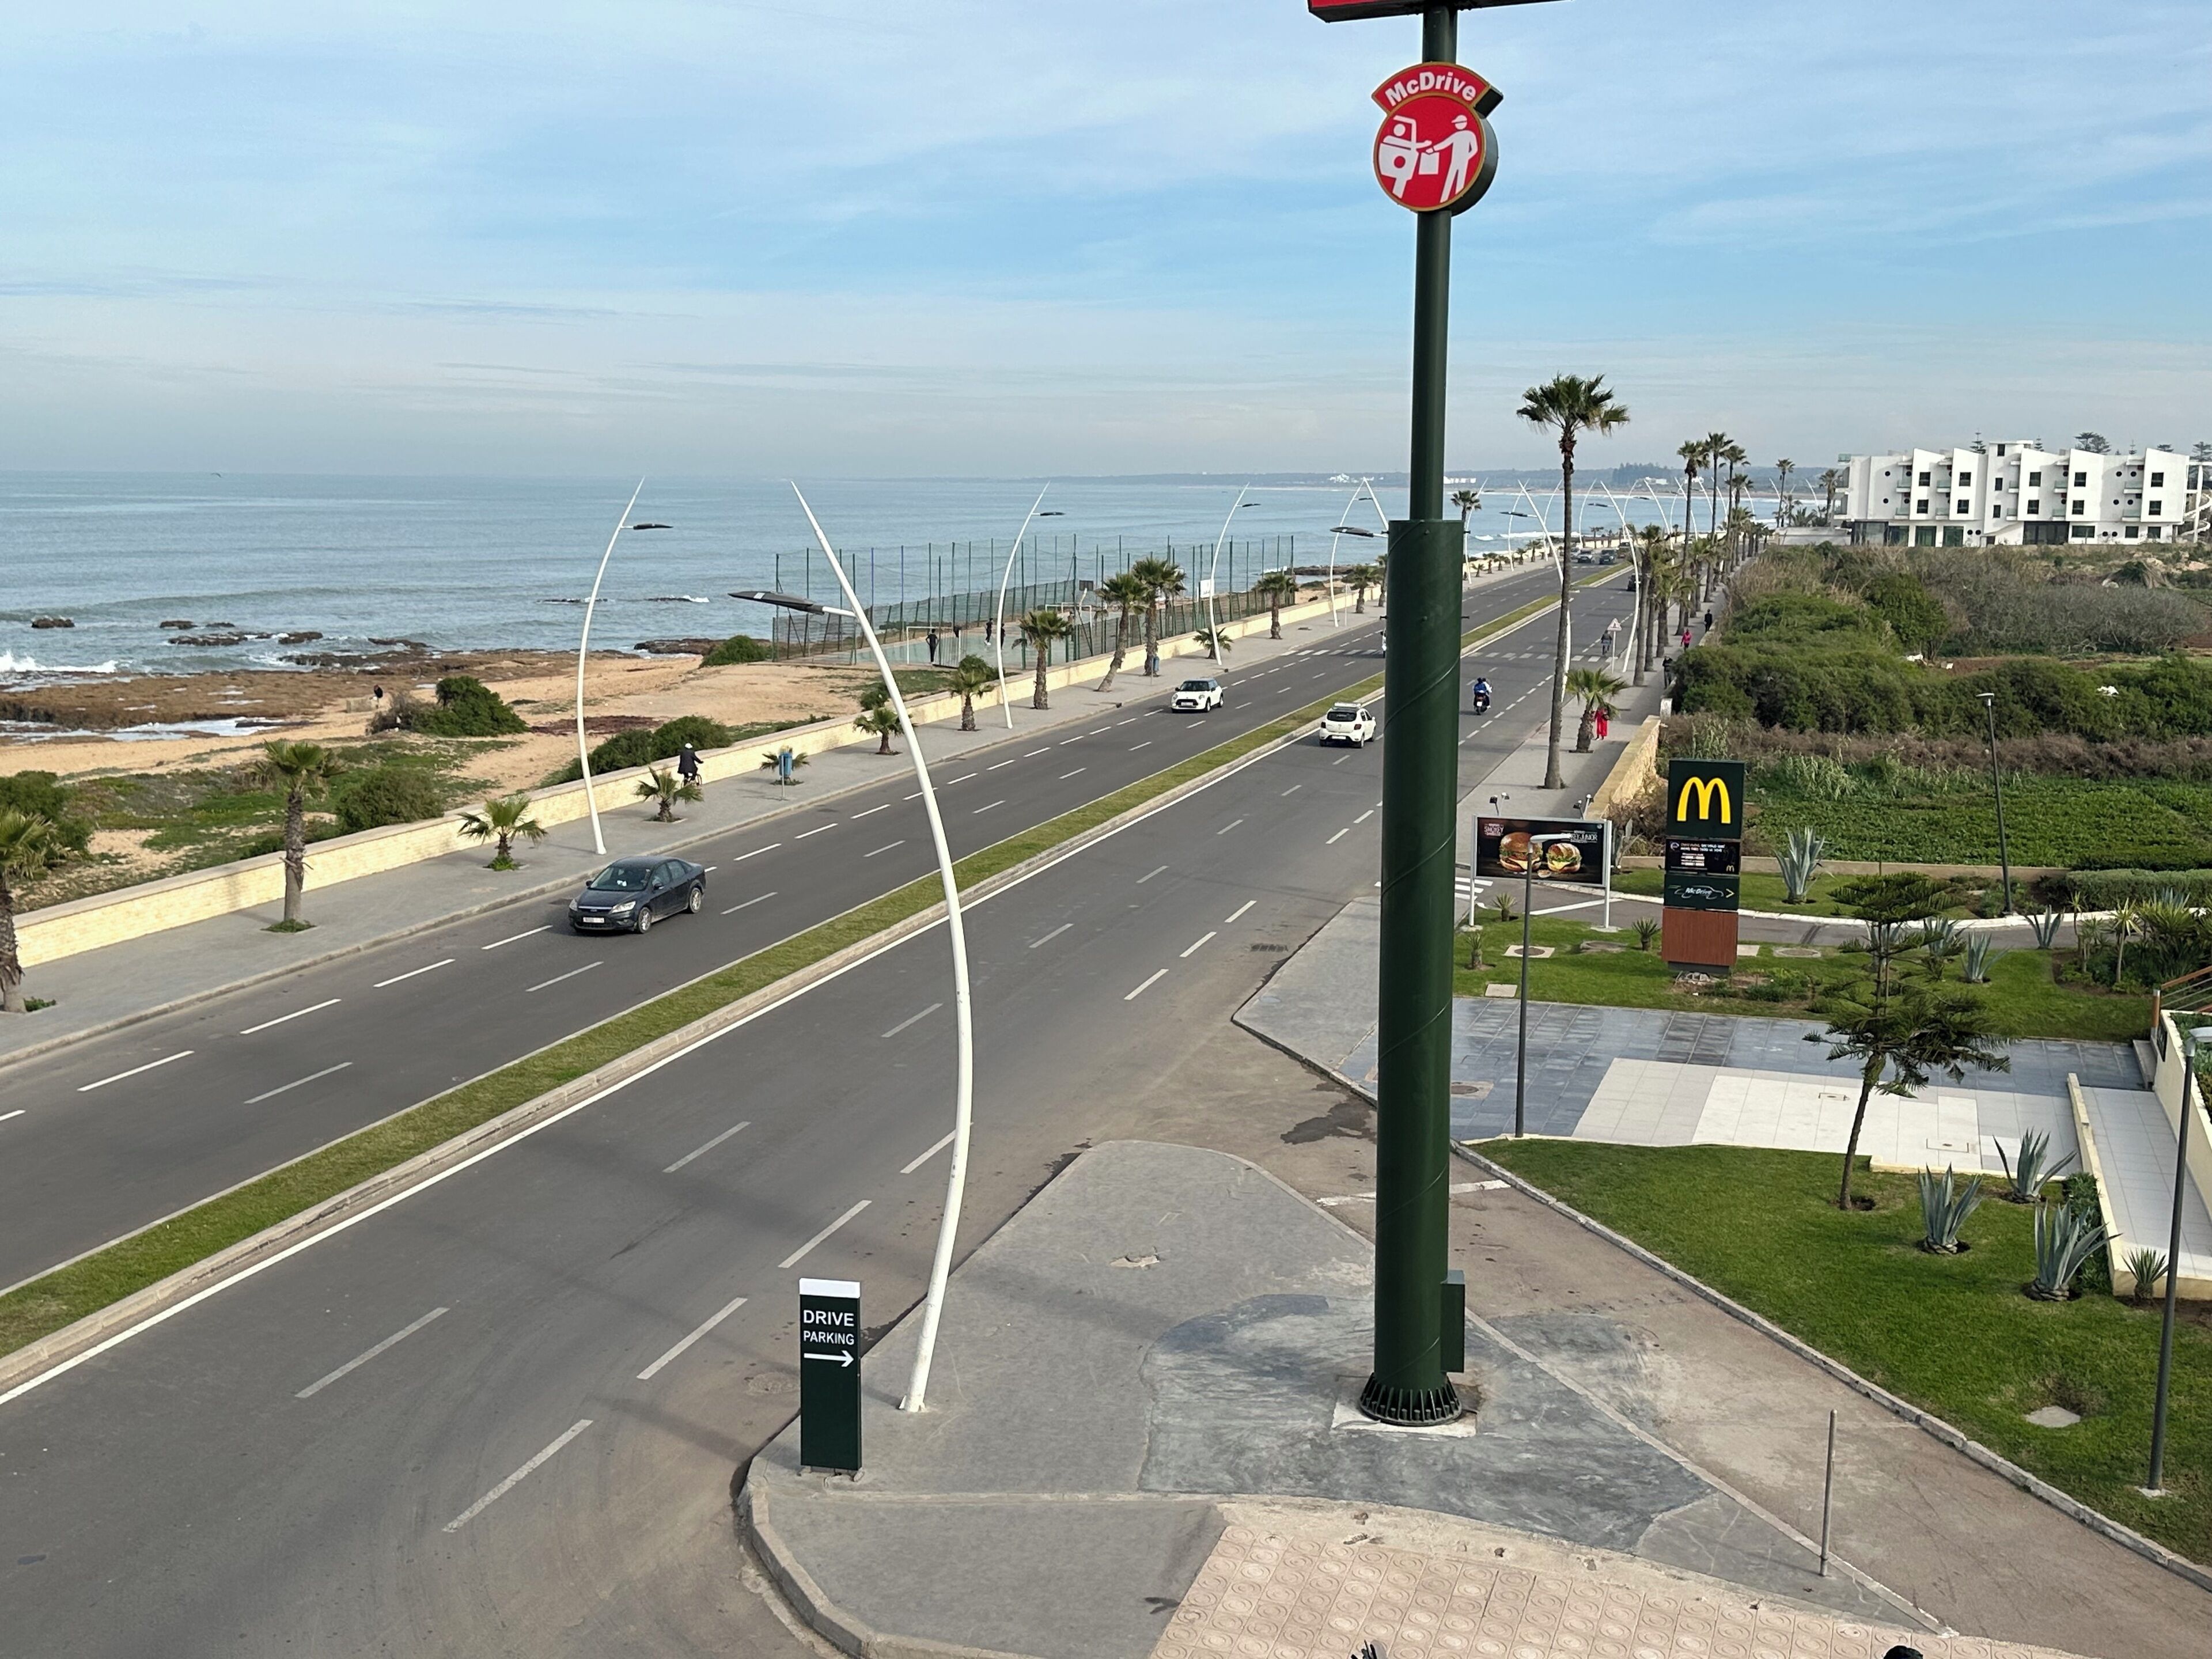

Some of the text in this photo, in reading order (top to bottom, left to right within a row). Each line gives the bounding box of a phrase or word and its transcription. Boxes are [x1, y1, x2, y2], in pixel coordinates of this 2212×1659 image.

[1385, 71, 1476, 107] McDrive
[803, 1309, 854, 1327] DRIVE
[803, 1330, 854, 1346] PARKING
